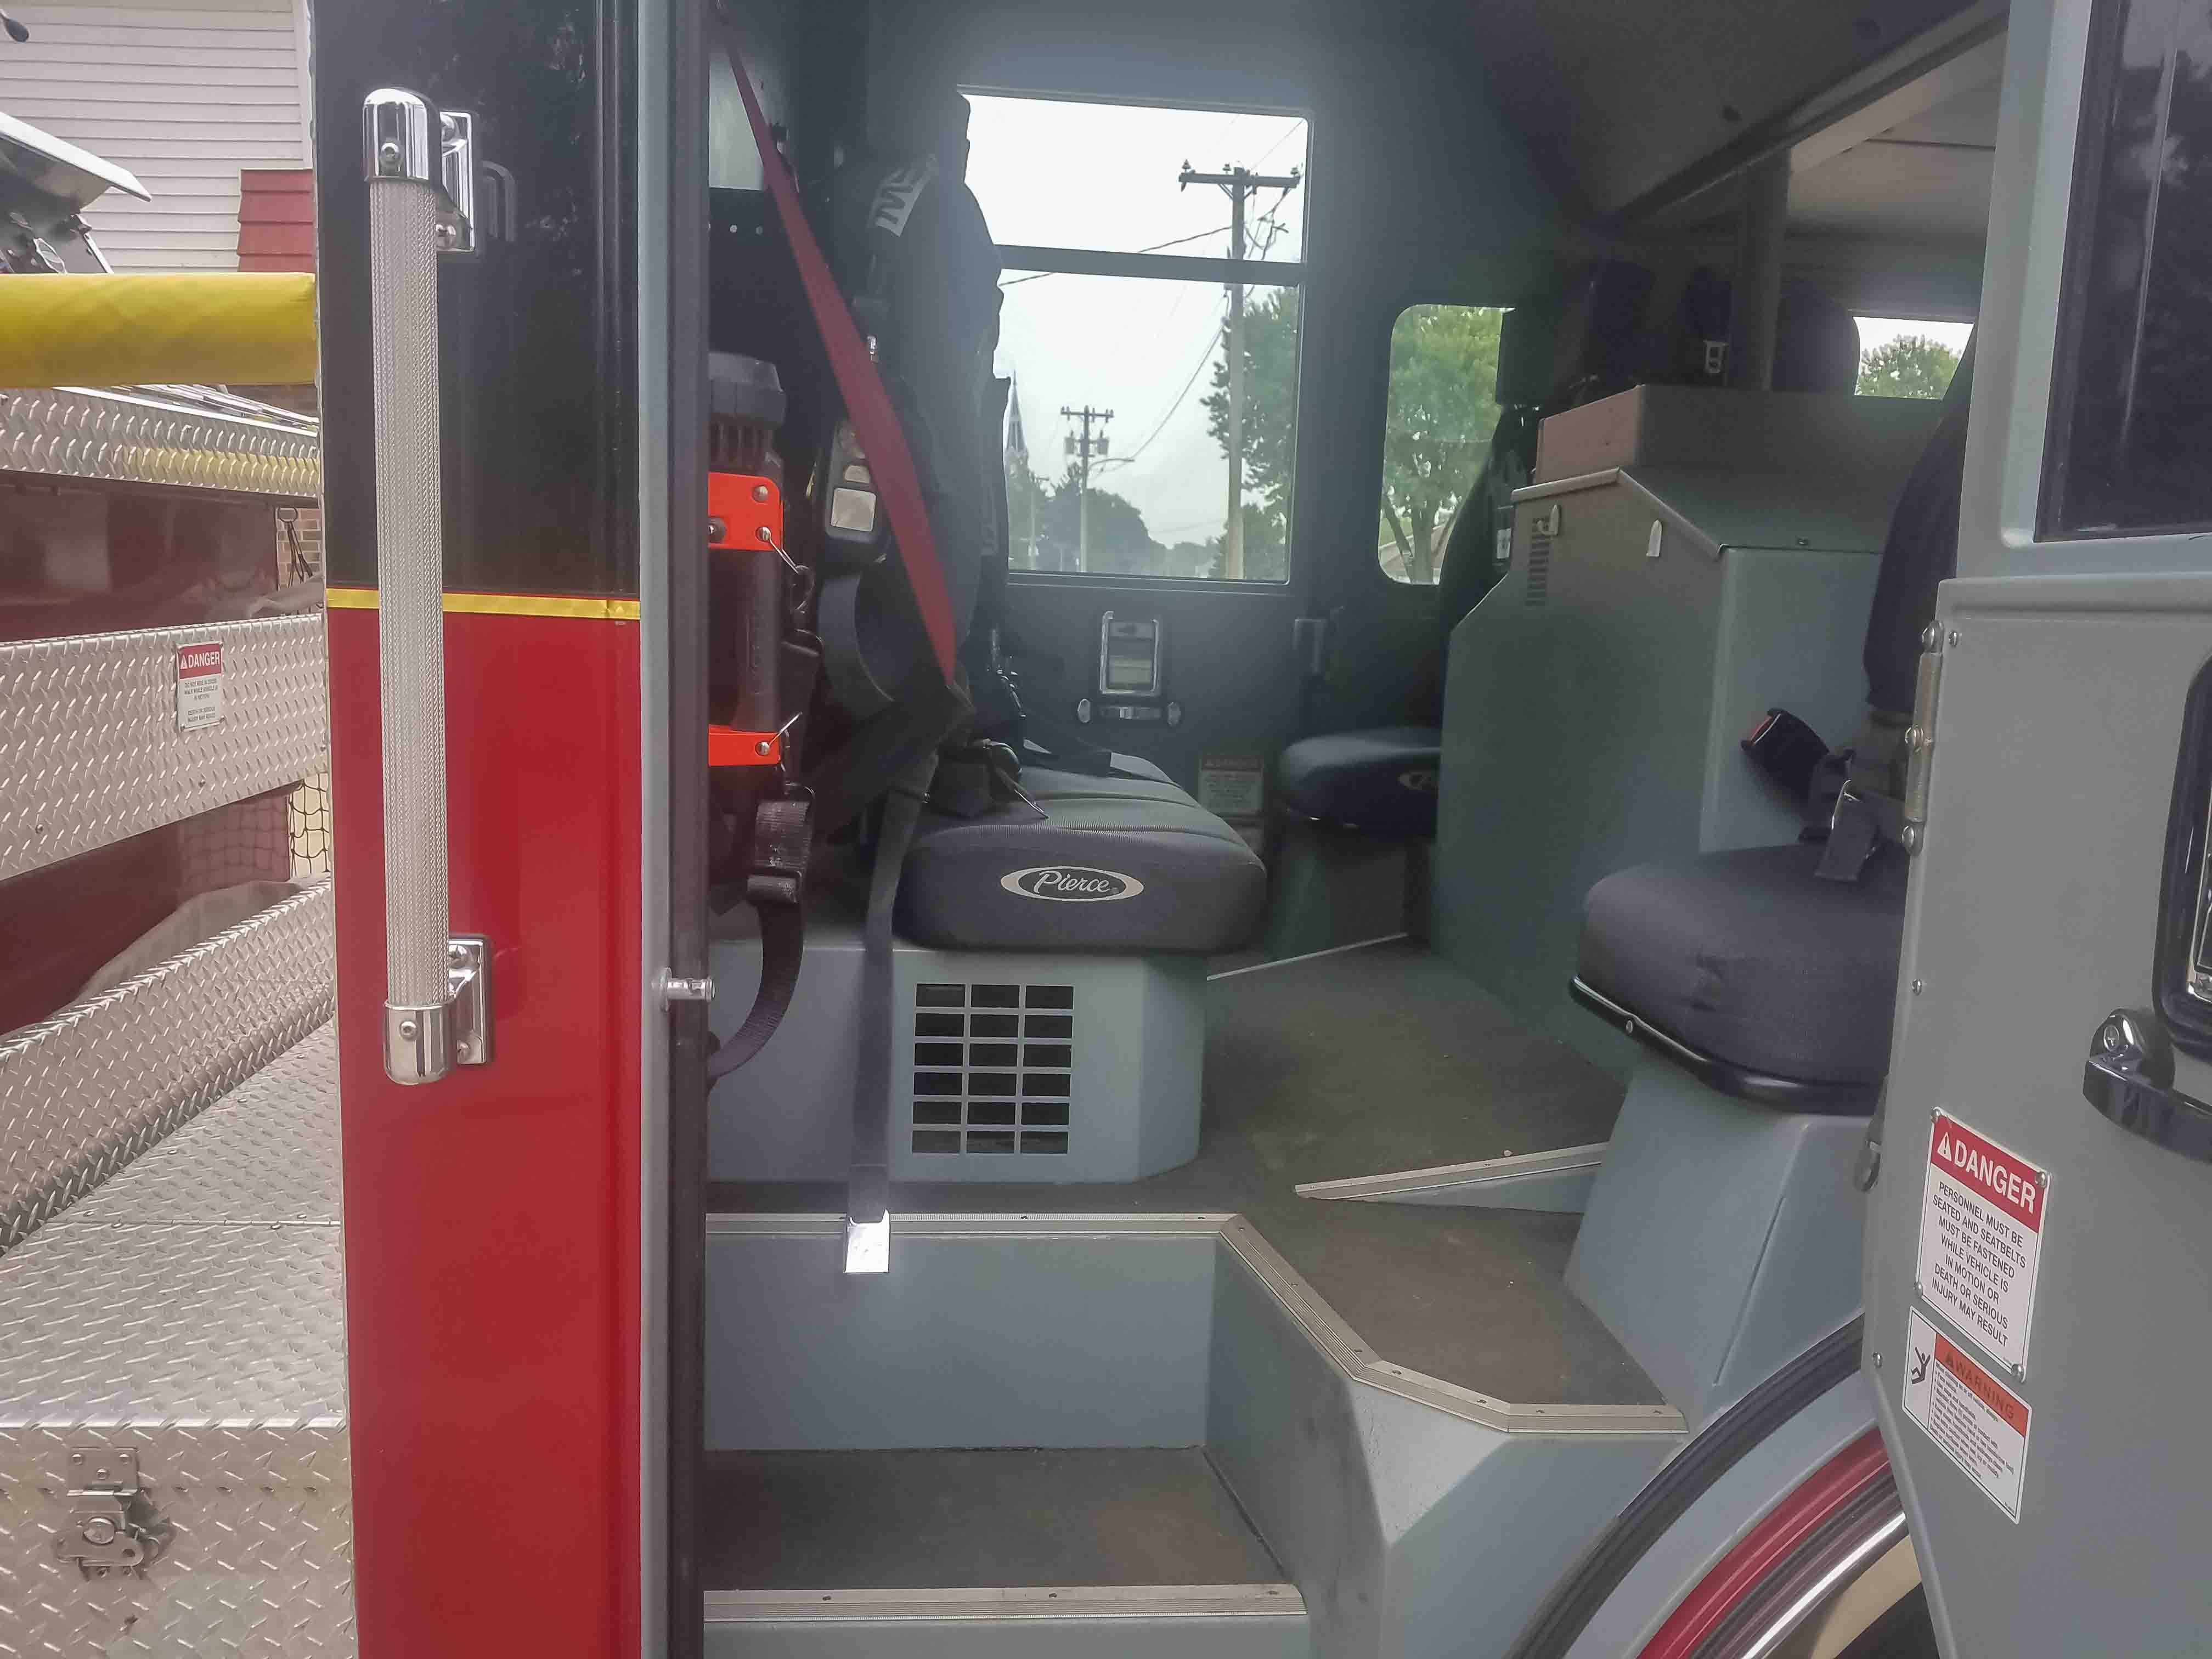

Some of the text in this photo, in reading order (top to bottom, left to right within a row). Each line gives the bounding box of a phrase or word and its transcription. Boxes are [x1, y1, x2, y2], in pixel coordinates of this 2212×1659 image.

[188, 651, 219, 668] DANGER
[1034, 871, 1110, 893] Pierce
[1955, 1140, 2036, 1214] DANGER
[1933, 1195, 2025, 1268] SEATED AND SEATBELTS
[1939, 1182, 2023, 1248] PERSONNEL MUST BE
[1939, 1216, 2014, 1278] MUST BE FASTENED
[1942, 1233, 2008, 1293] WHILE VEHICLE IS
[1935, 1263, 2007, 1329] DEATH OR SERIOUS
[1946, 1255, 1999, 1304] IN MOTION OR
[1932, 1277, 2008, 1346] INJURY MAY RESULT
[1956, 1360, 2014, 1418] WARNING
